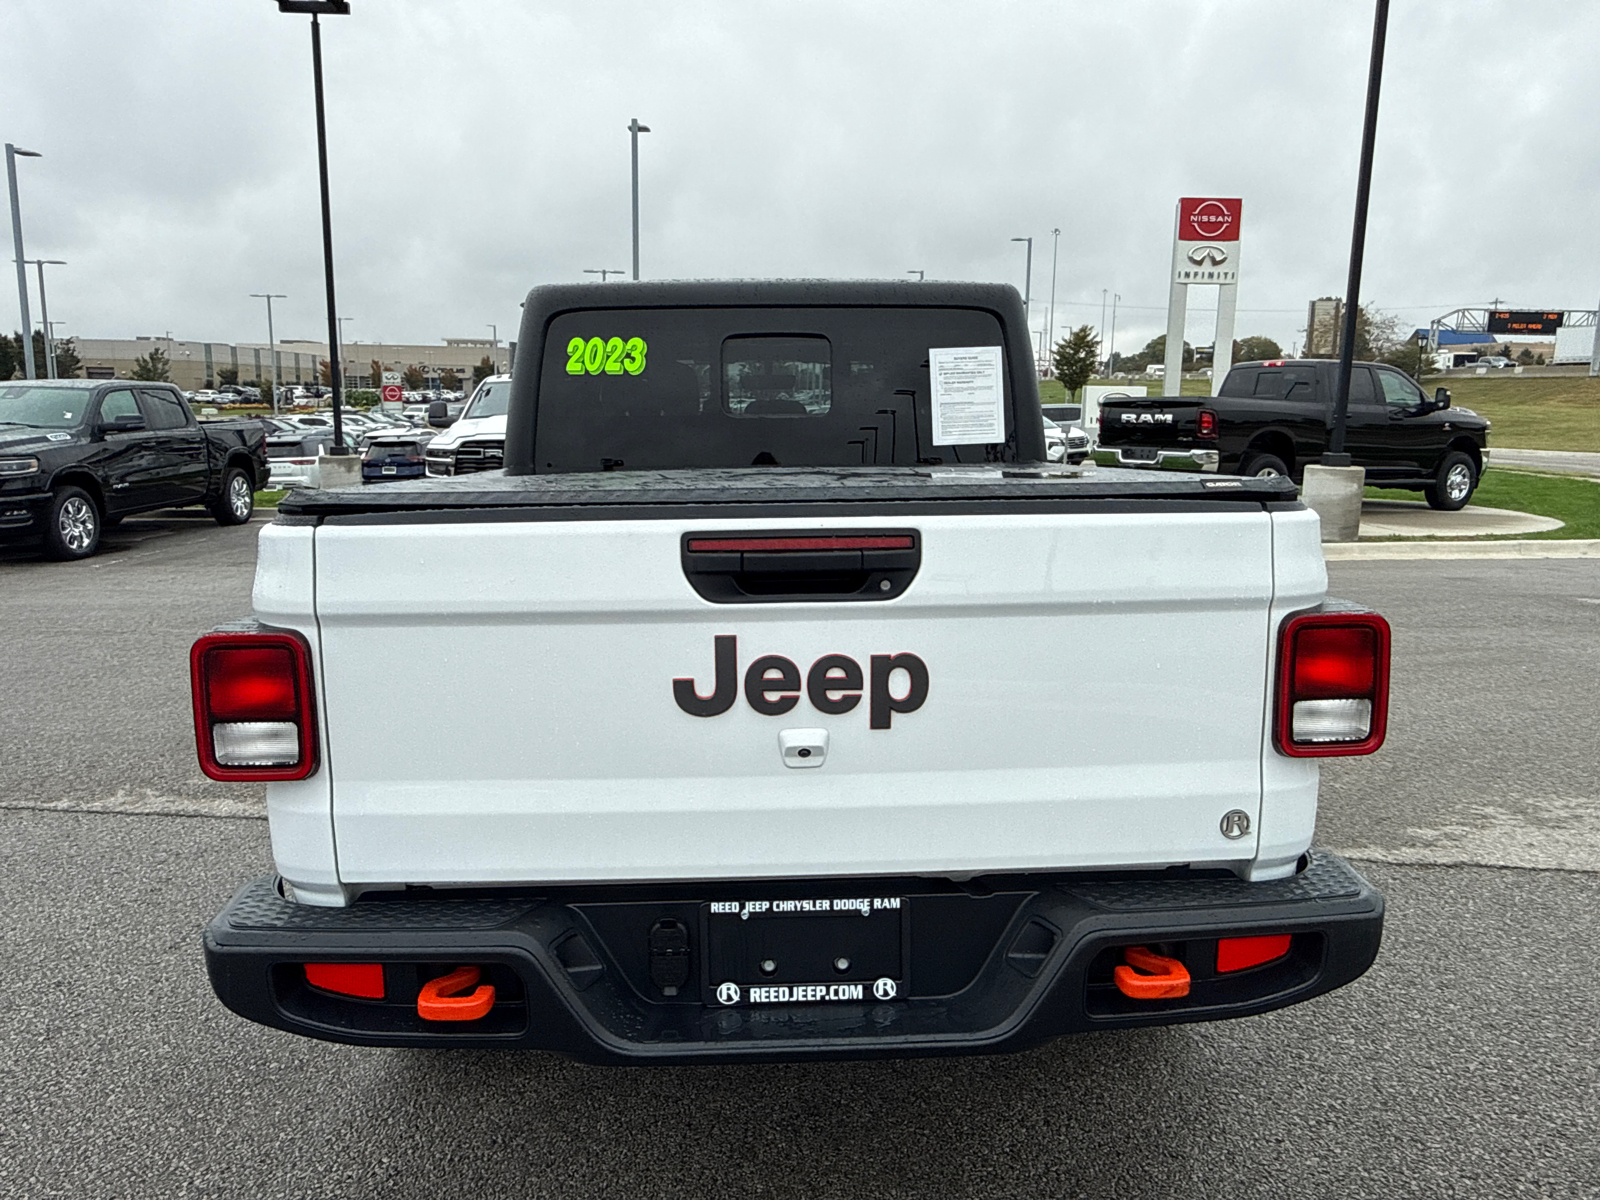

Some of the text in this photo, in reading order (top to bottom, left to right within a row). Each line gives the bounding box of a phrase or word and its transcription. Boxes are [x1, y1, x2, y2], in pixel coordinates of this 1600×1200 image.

[1177, 271, 1235, 280] INFINITI
[566, 336, 648, 376] 2023
[1121, 413, 1173, 424] RAM
[672, 635, 930, 730] Jeep
[711, 898, 900, 914] REED JEEP CHRYSLER DODGE RAM
[750, 984, 863, 1003] REEDJEEP.COM
